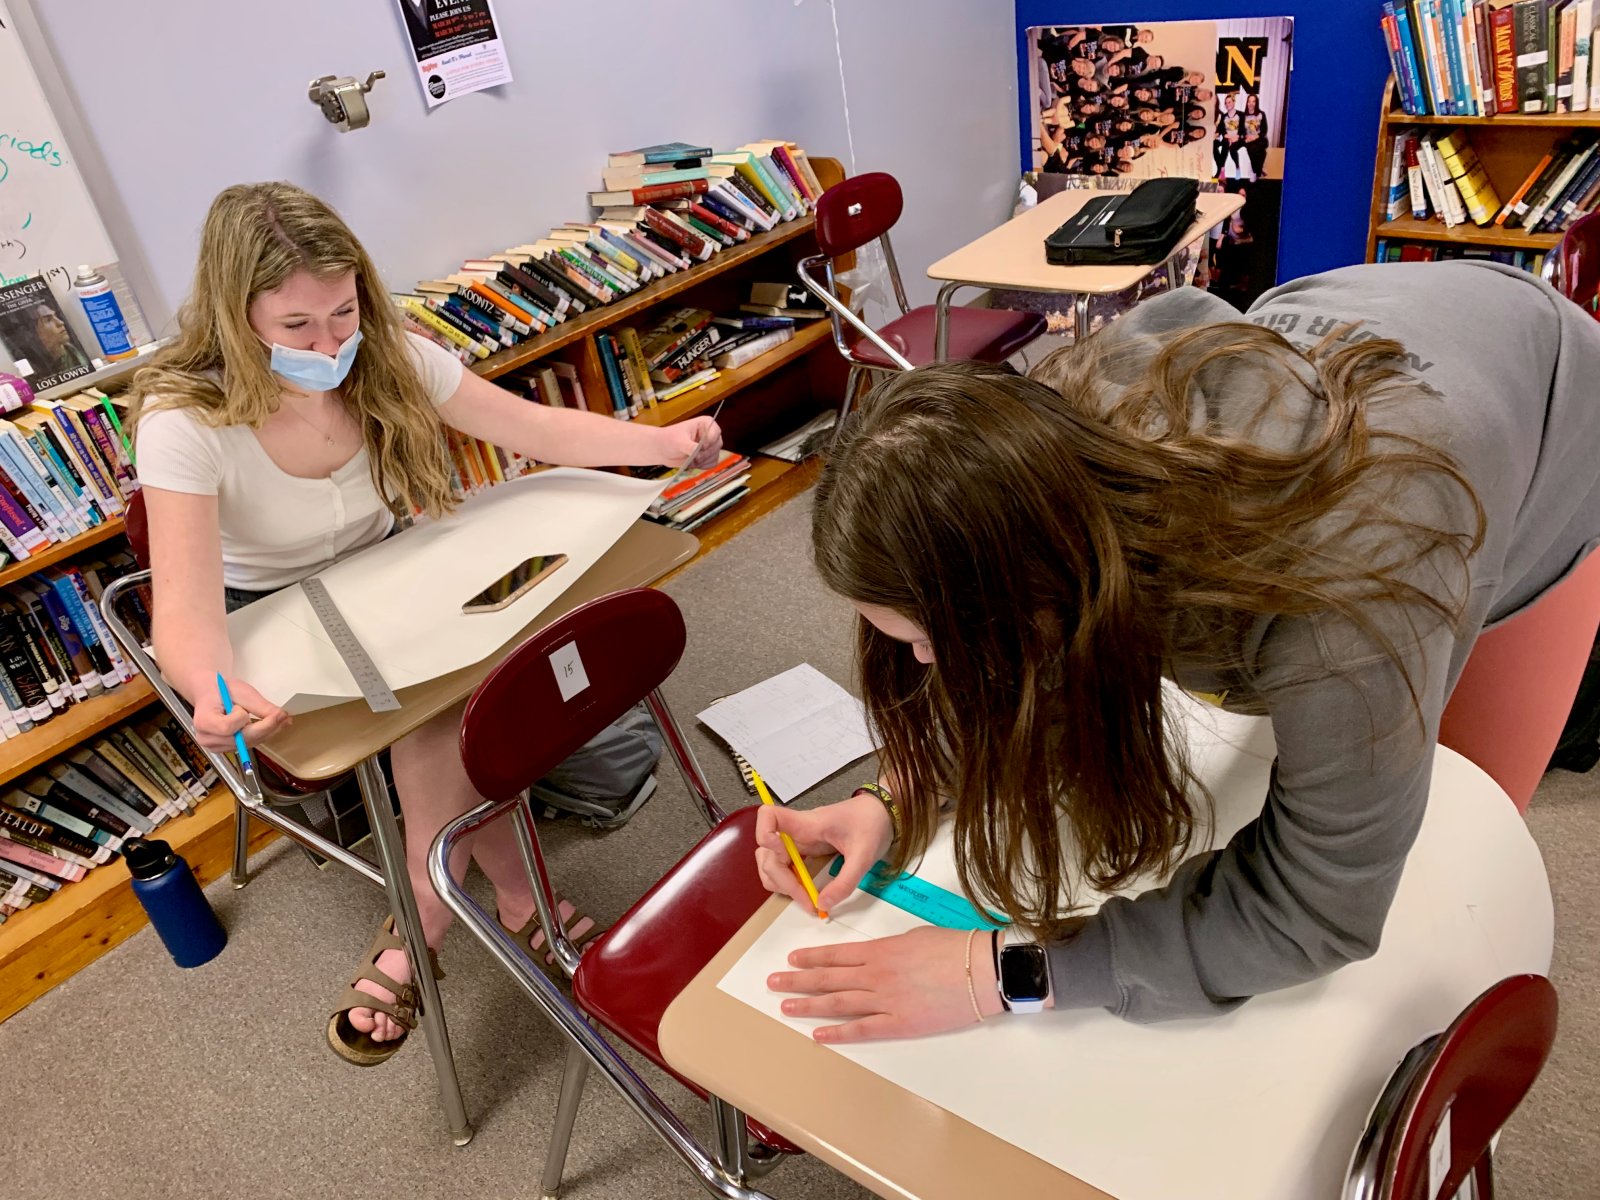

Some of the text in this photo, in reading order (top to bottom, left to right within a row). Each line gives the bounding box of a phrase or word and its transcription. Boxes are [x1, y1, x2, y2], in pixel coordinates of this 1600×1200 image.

[430, 5, 472, 22] PLEASE JOIN US
[1526, 5, 1538, 40] CLASSICAL
[1496, 24, 1516, 101] MARK MY WORDS
[460, 285, 496, 315] KOONTZ
[678, 336, 712, 368] HUNGER
[36, 364, 90, 392] LOIS LOWRY
[64, 584, 102, 647] COLD MOUNTAIN
[27, 641, 44, 665] PIGMAN'S
[106, 638, 117, 652] TRUTH
[9, 655, 22, 664] Lily
[9, 660, 28, 670] White
[564, 660, 574, 678] 15
[0, 809, 48, 838] ZEALOT
